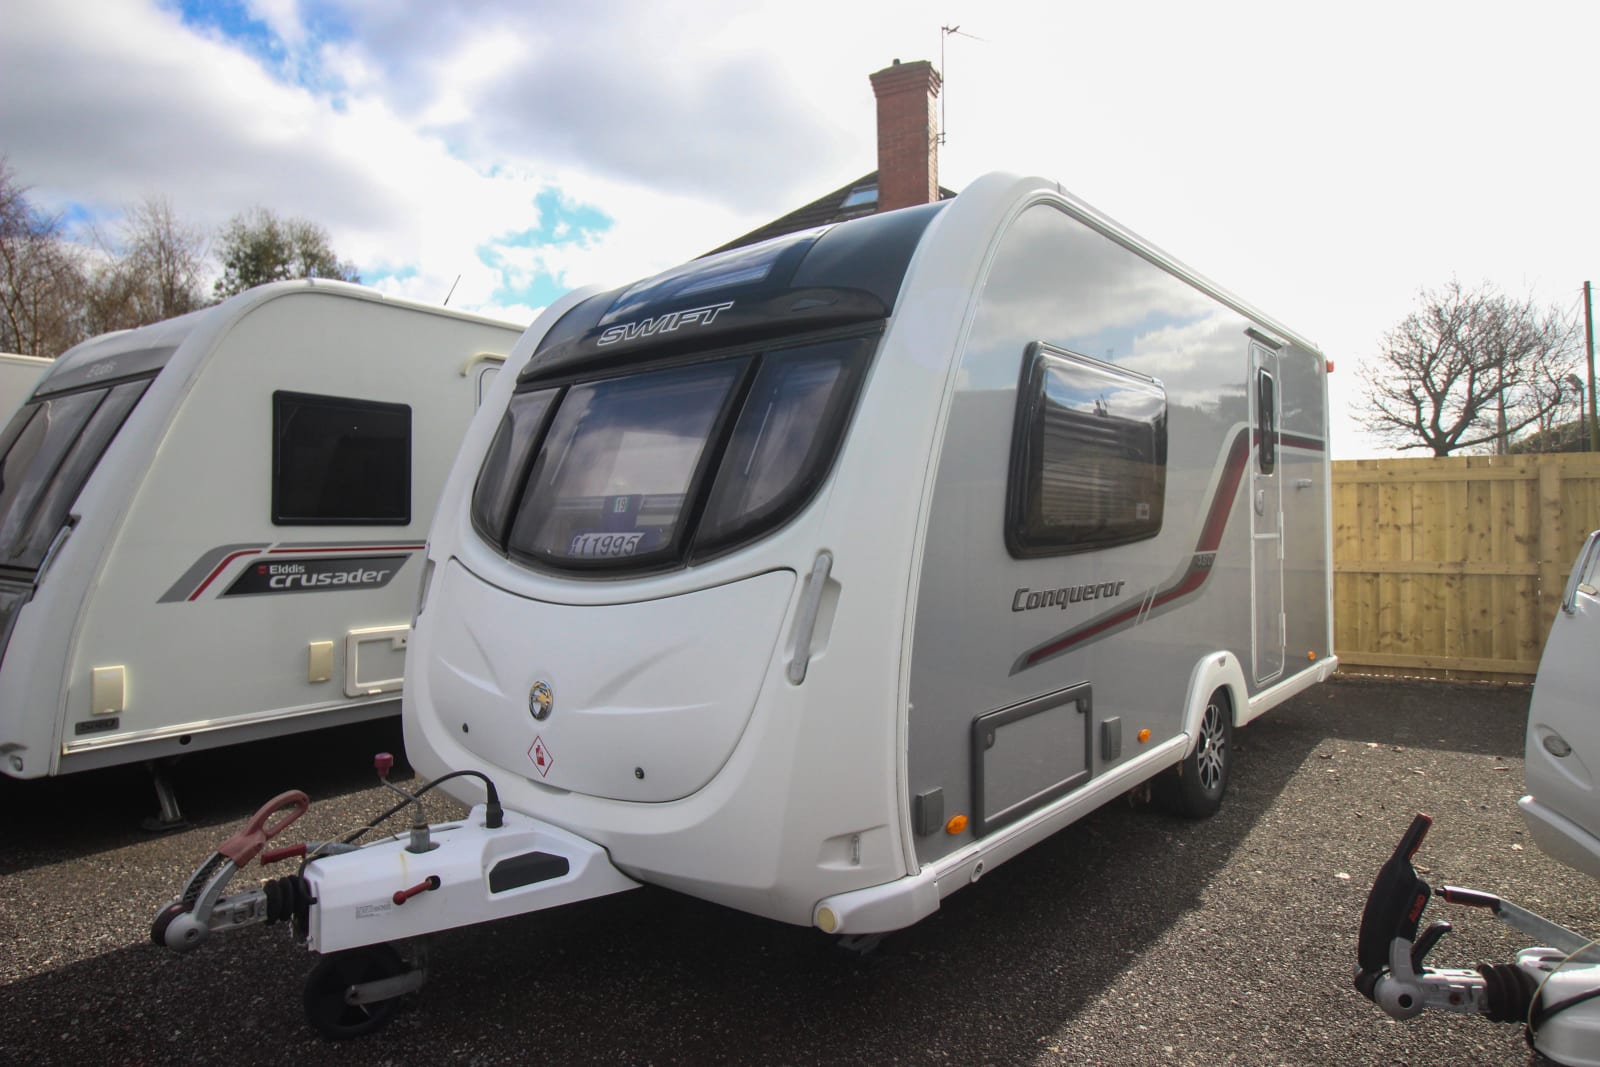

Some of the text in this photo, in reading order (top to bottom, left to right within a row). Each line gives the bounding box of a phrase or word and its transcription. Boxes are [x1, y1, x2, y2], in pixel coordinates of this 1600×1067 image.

[597, 300, 735, 346] SWIFT
[269, 564, 305, 575] Elddis
[1011, 580, 1125, 612] Conqueror
